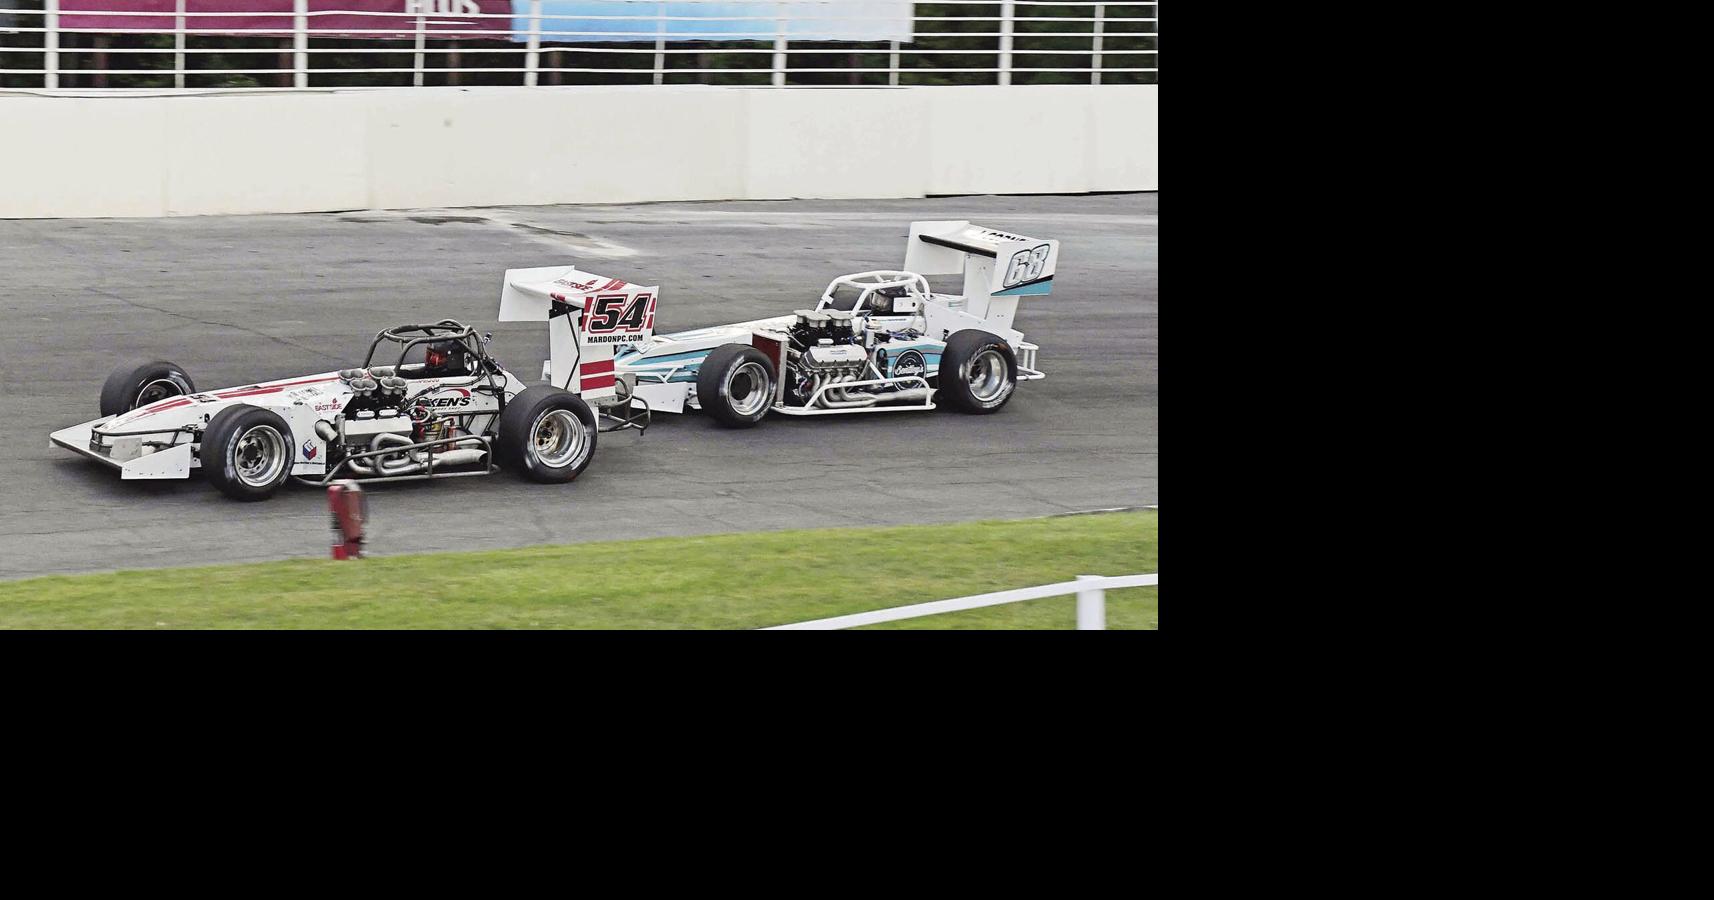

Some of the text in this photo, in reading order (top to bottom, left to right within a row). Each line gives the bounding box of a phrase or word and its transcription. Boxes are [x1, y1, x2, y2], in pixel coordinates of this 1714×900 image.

[1003, 243, 1050, 288] 68
[588, 293, 651, 334] 54
[587, 335, 643, 343] MARDONPC.COM
